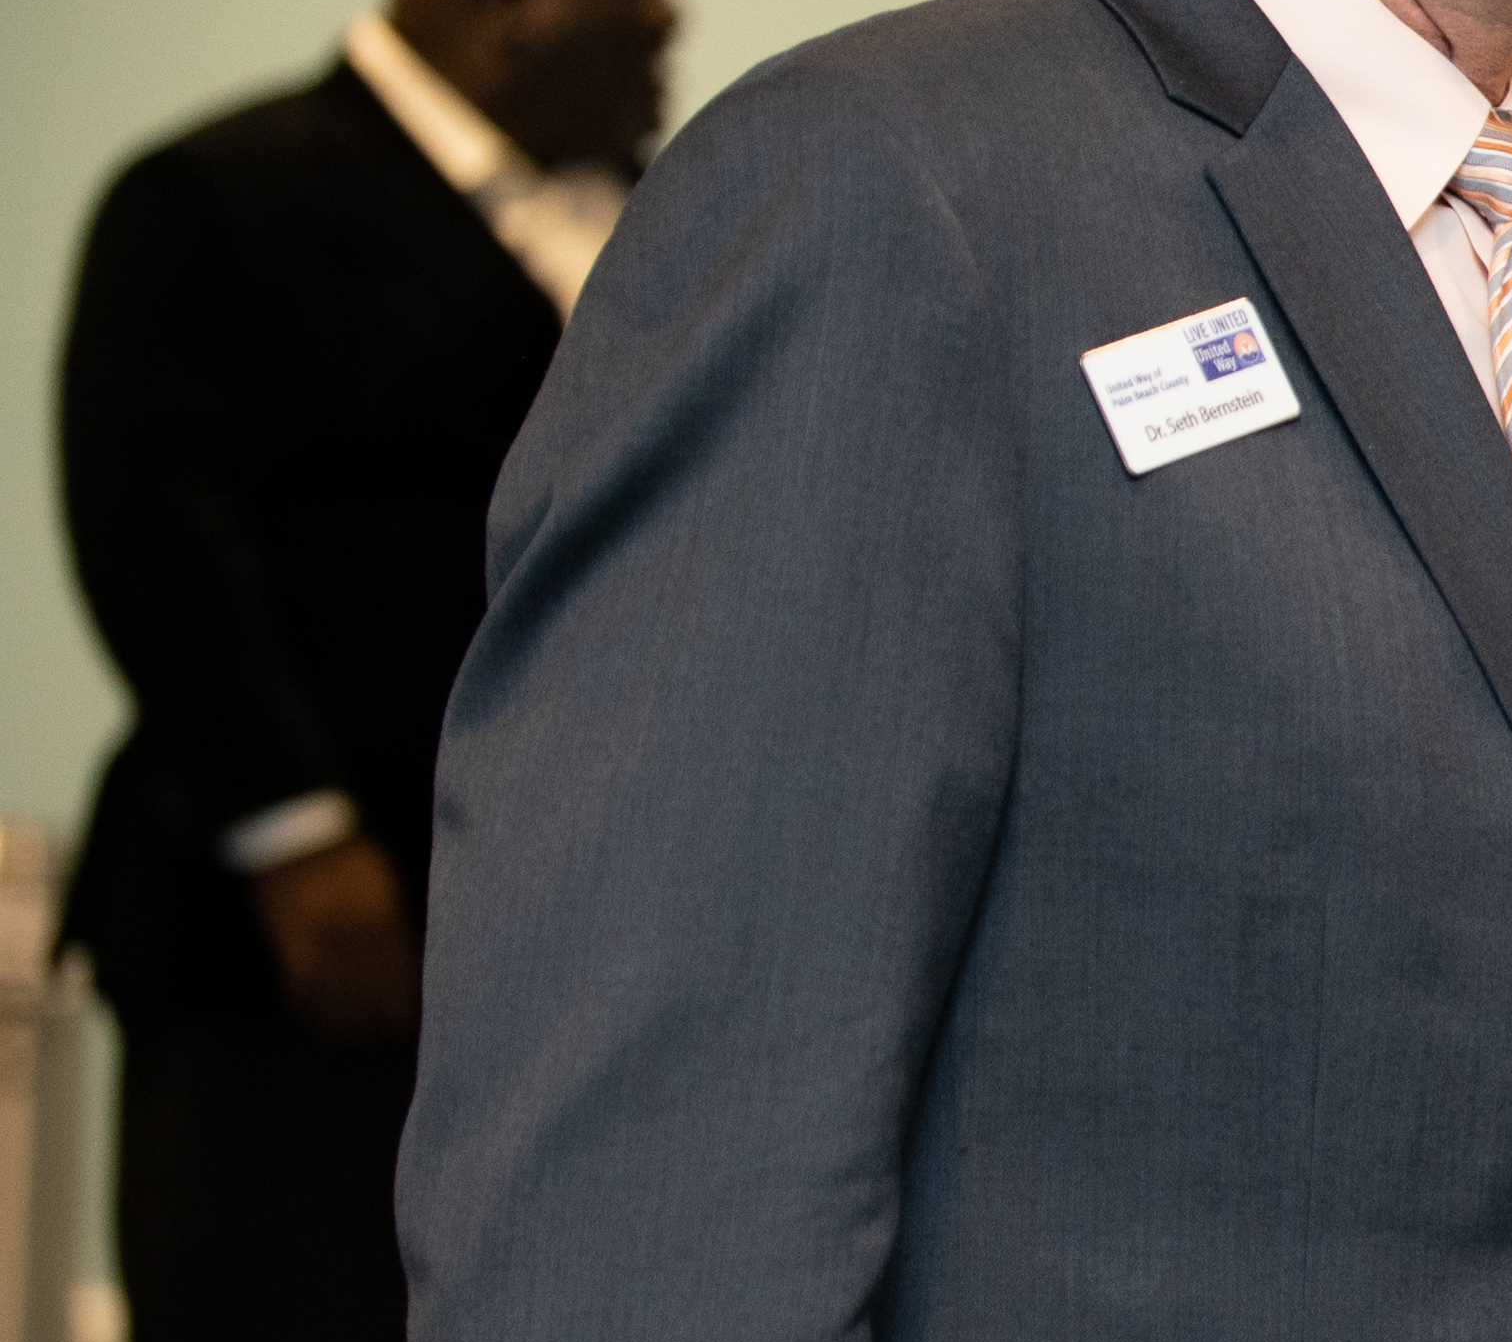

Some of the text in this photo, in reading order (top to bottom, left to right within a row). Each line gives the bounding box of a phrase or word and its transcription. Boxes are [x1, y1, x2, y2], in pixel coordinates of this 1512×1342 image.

[1183, 309, 1249, 344] LIVE UNITED
[1194, 339, 1232, 362] United
[1213, 356, 1237, 372] Way
[1145, 388, 1265, 442] Dr. Seth Bernstein
